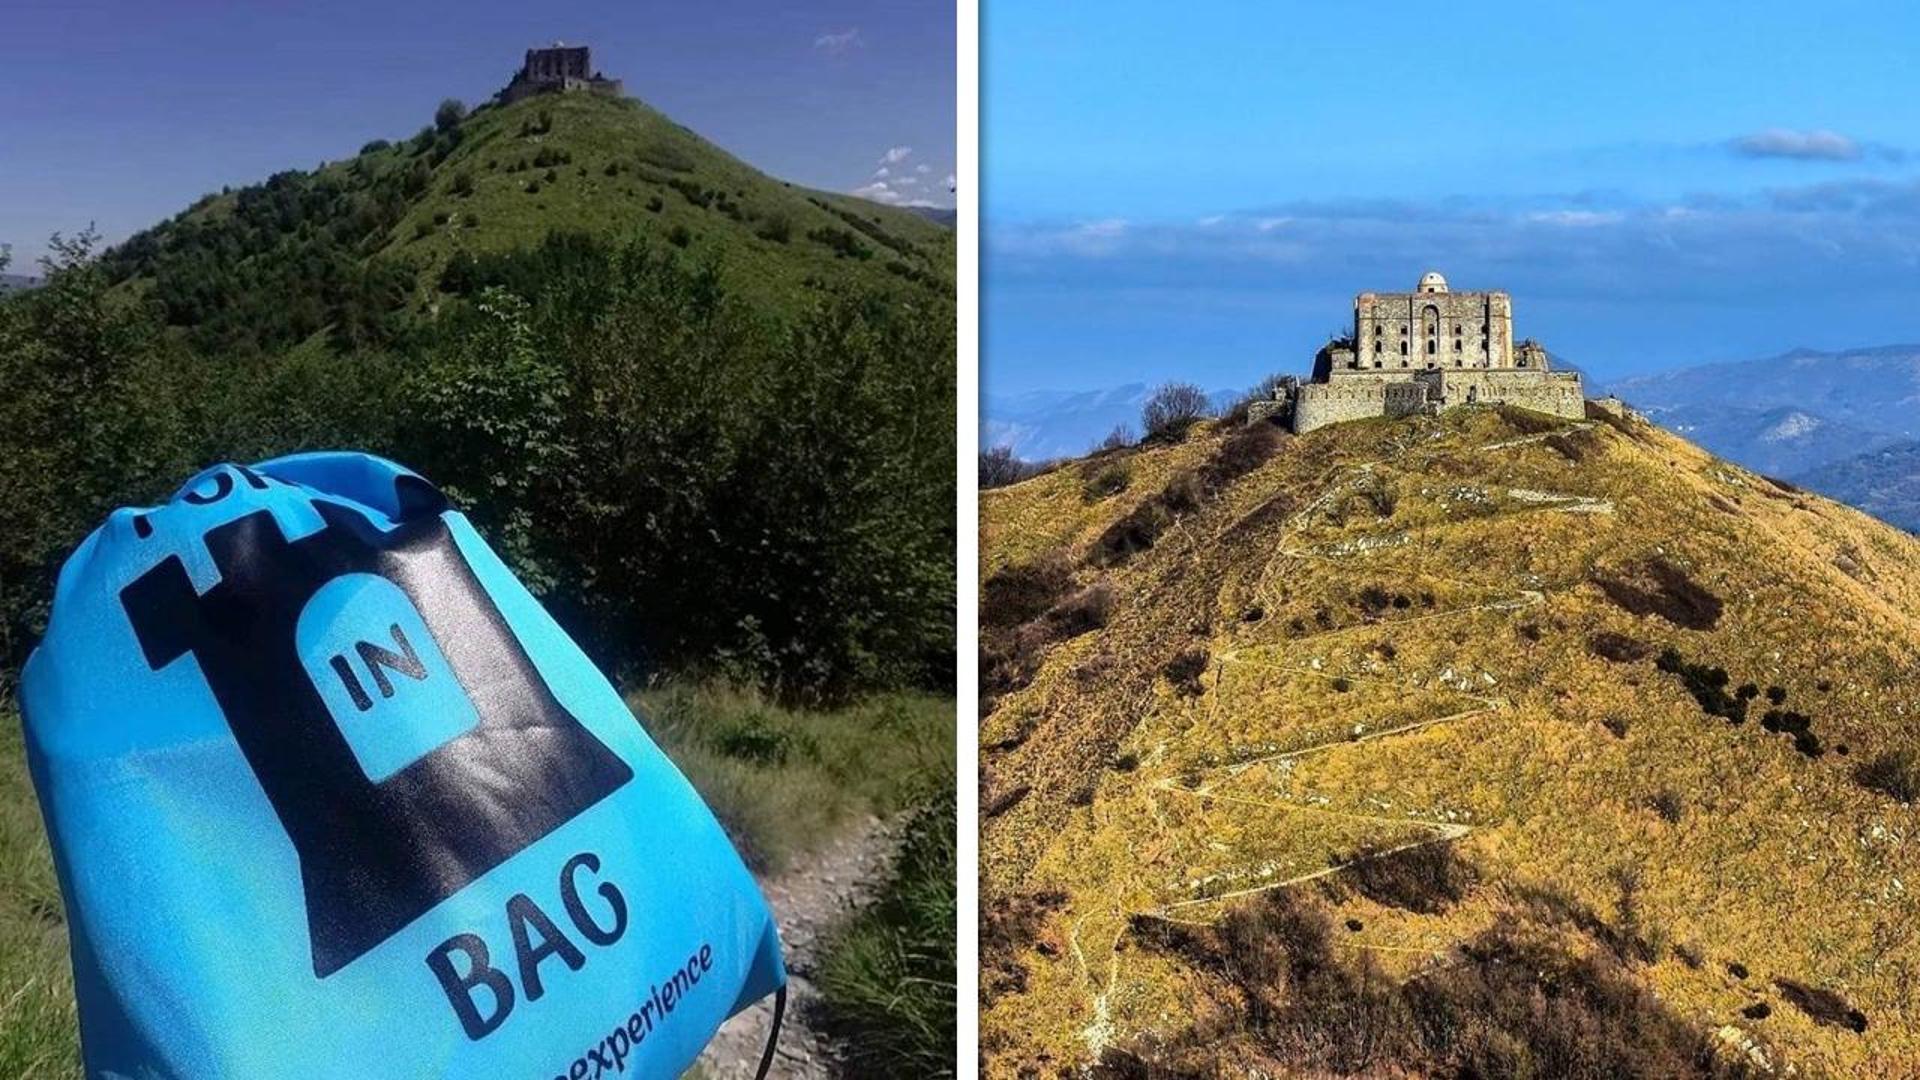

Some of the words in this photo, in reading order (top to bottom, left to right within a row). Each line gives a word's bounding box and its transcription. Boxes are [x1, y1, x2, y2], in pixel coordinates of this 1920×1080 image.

[329, 623, 428, 711] IN
[425, 853, 628, 1041] BAG
[554, 943, 713, 1080] experience
